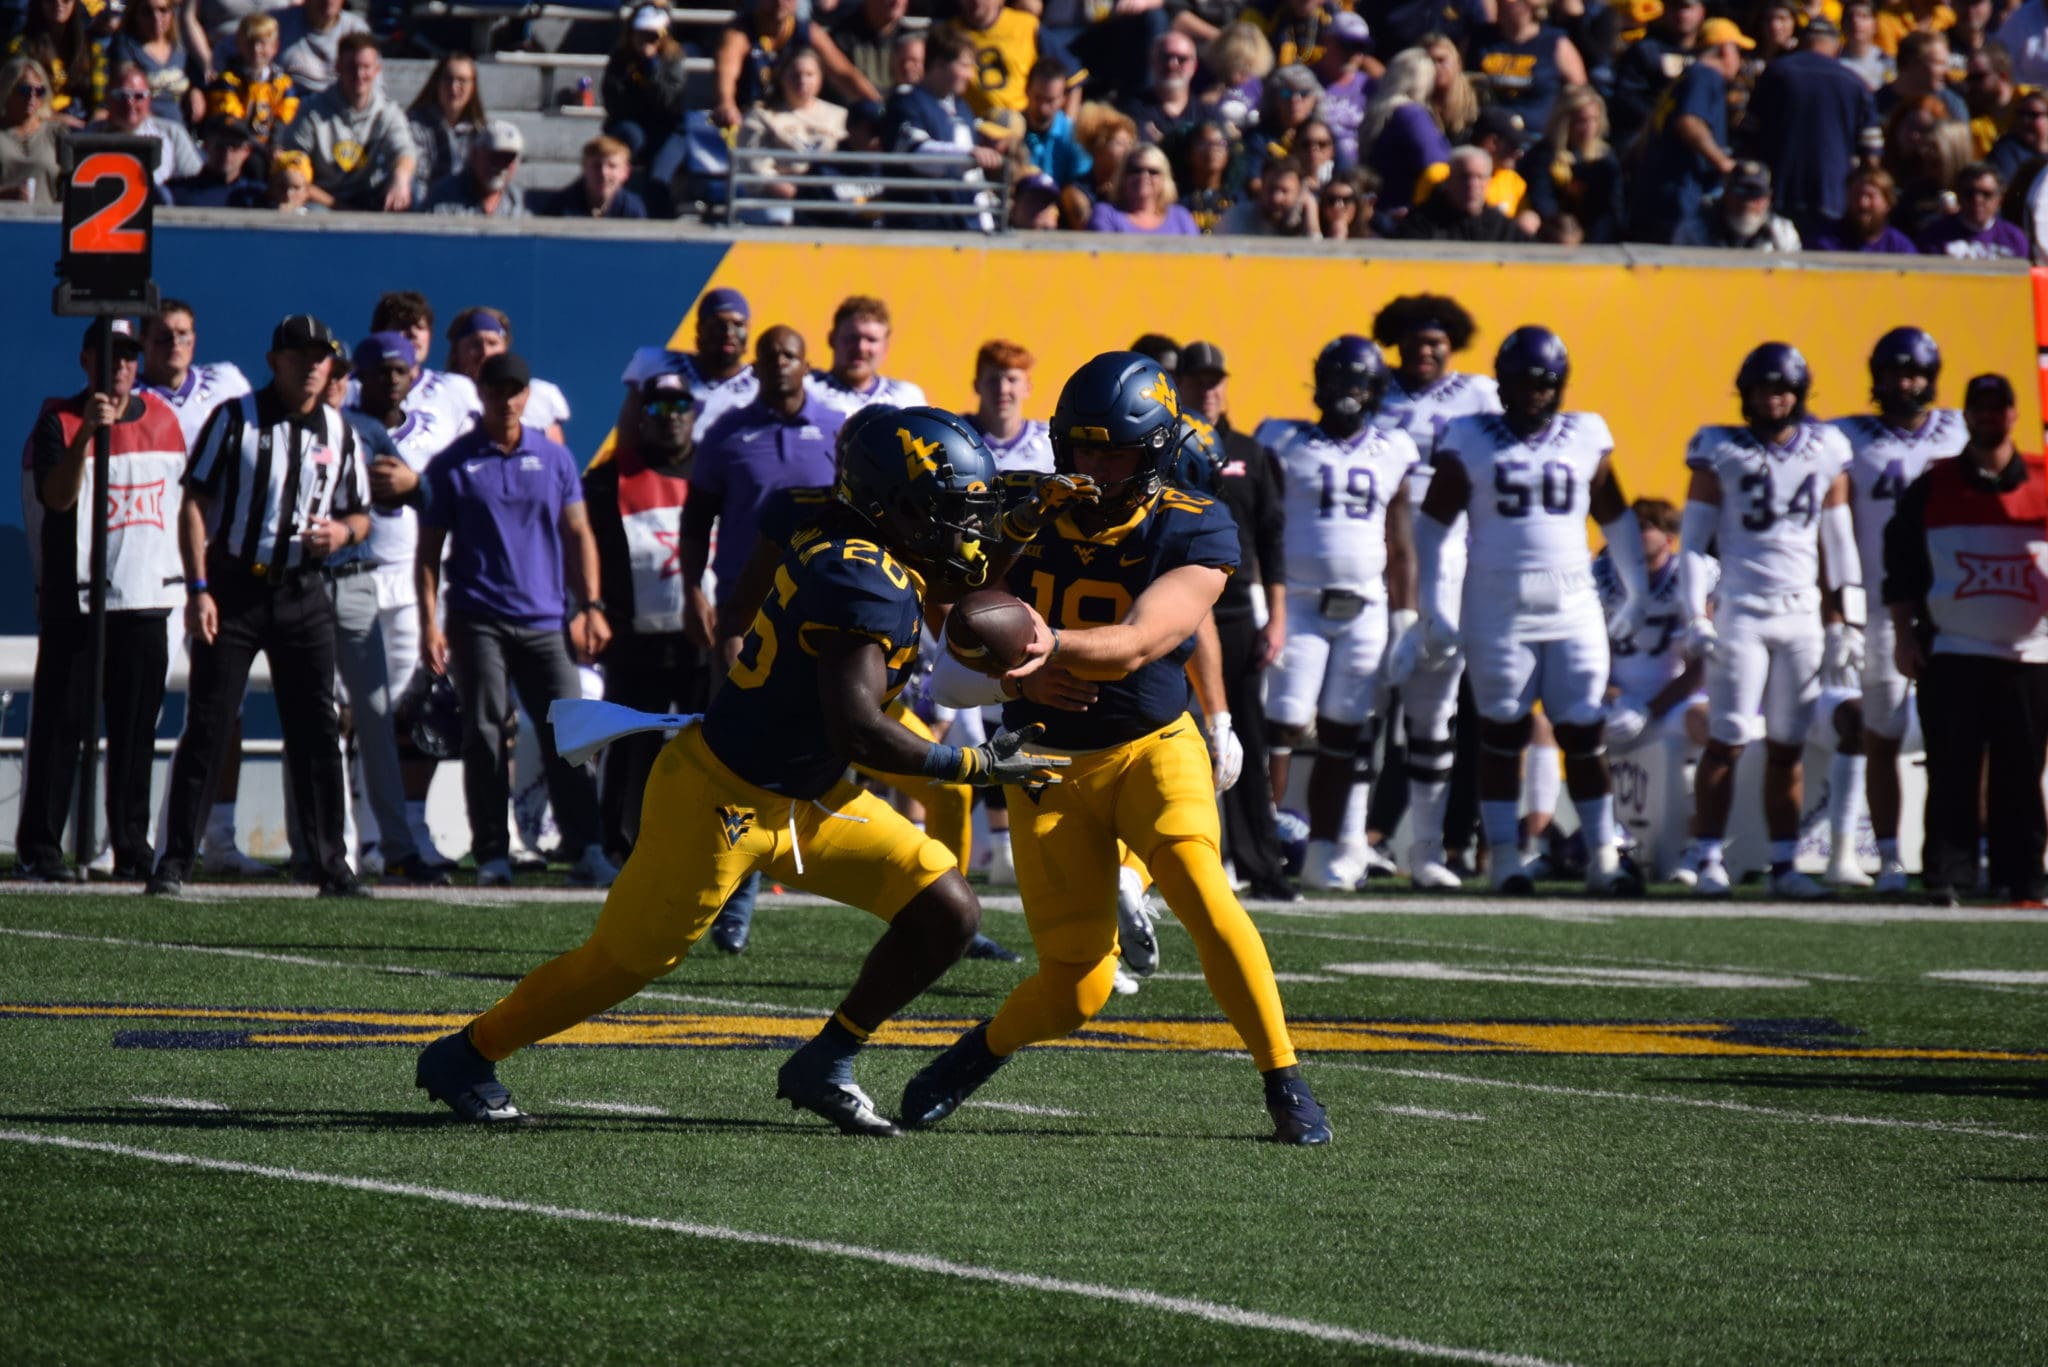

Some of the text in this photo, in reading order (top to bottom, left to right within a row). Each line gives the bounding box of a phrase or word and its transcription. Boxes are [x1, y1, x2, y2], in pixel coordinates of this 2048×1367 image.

[70, 153, 148, 253] 2
[1319, 463, 1376, 520] 19
[1496, 460, 1575, 517] 50
[1740, 472, 1818, 532] 34
